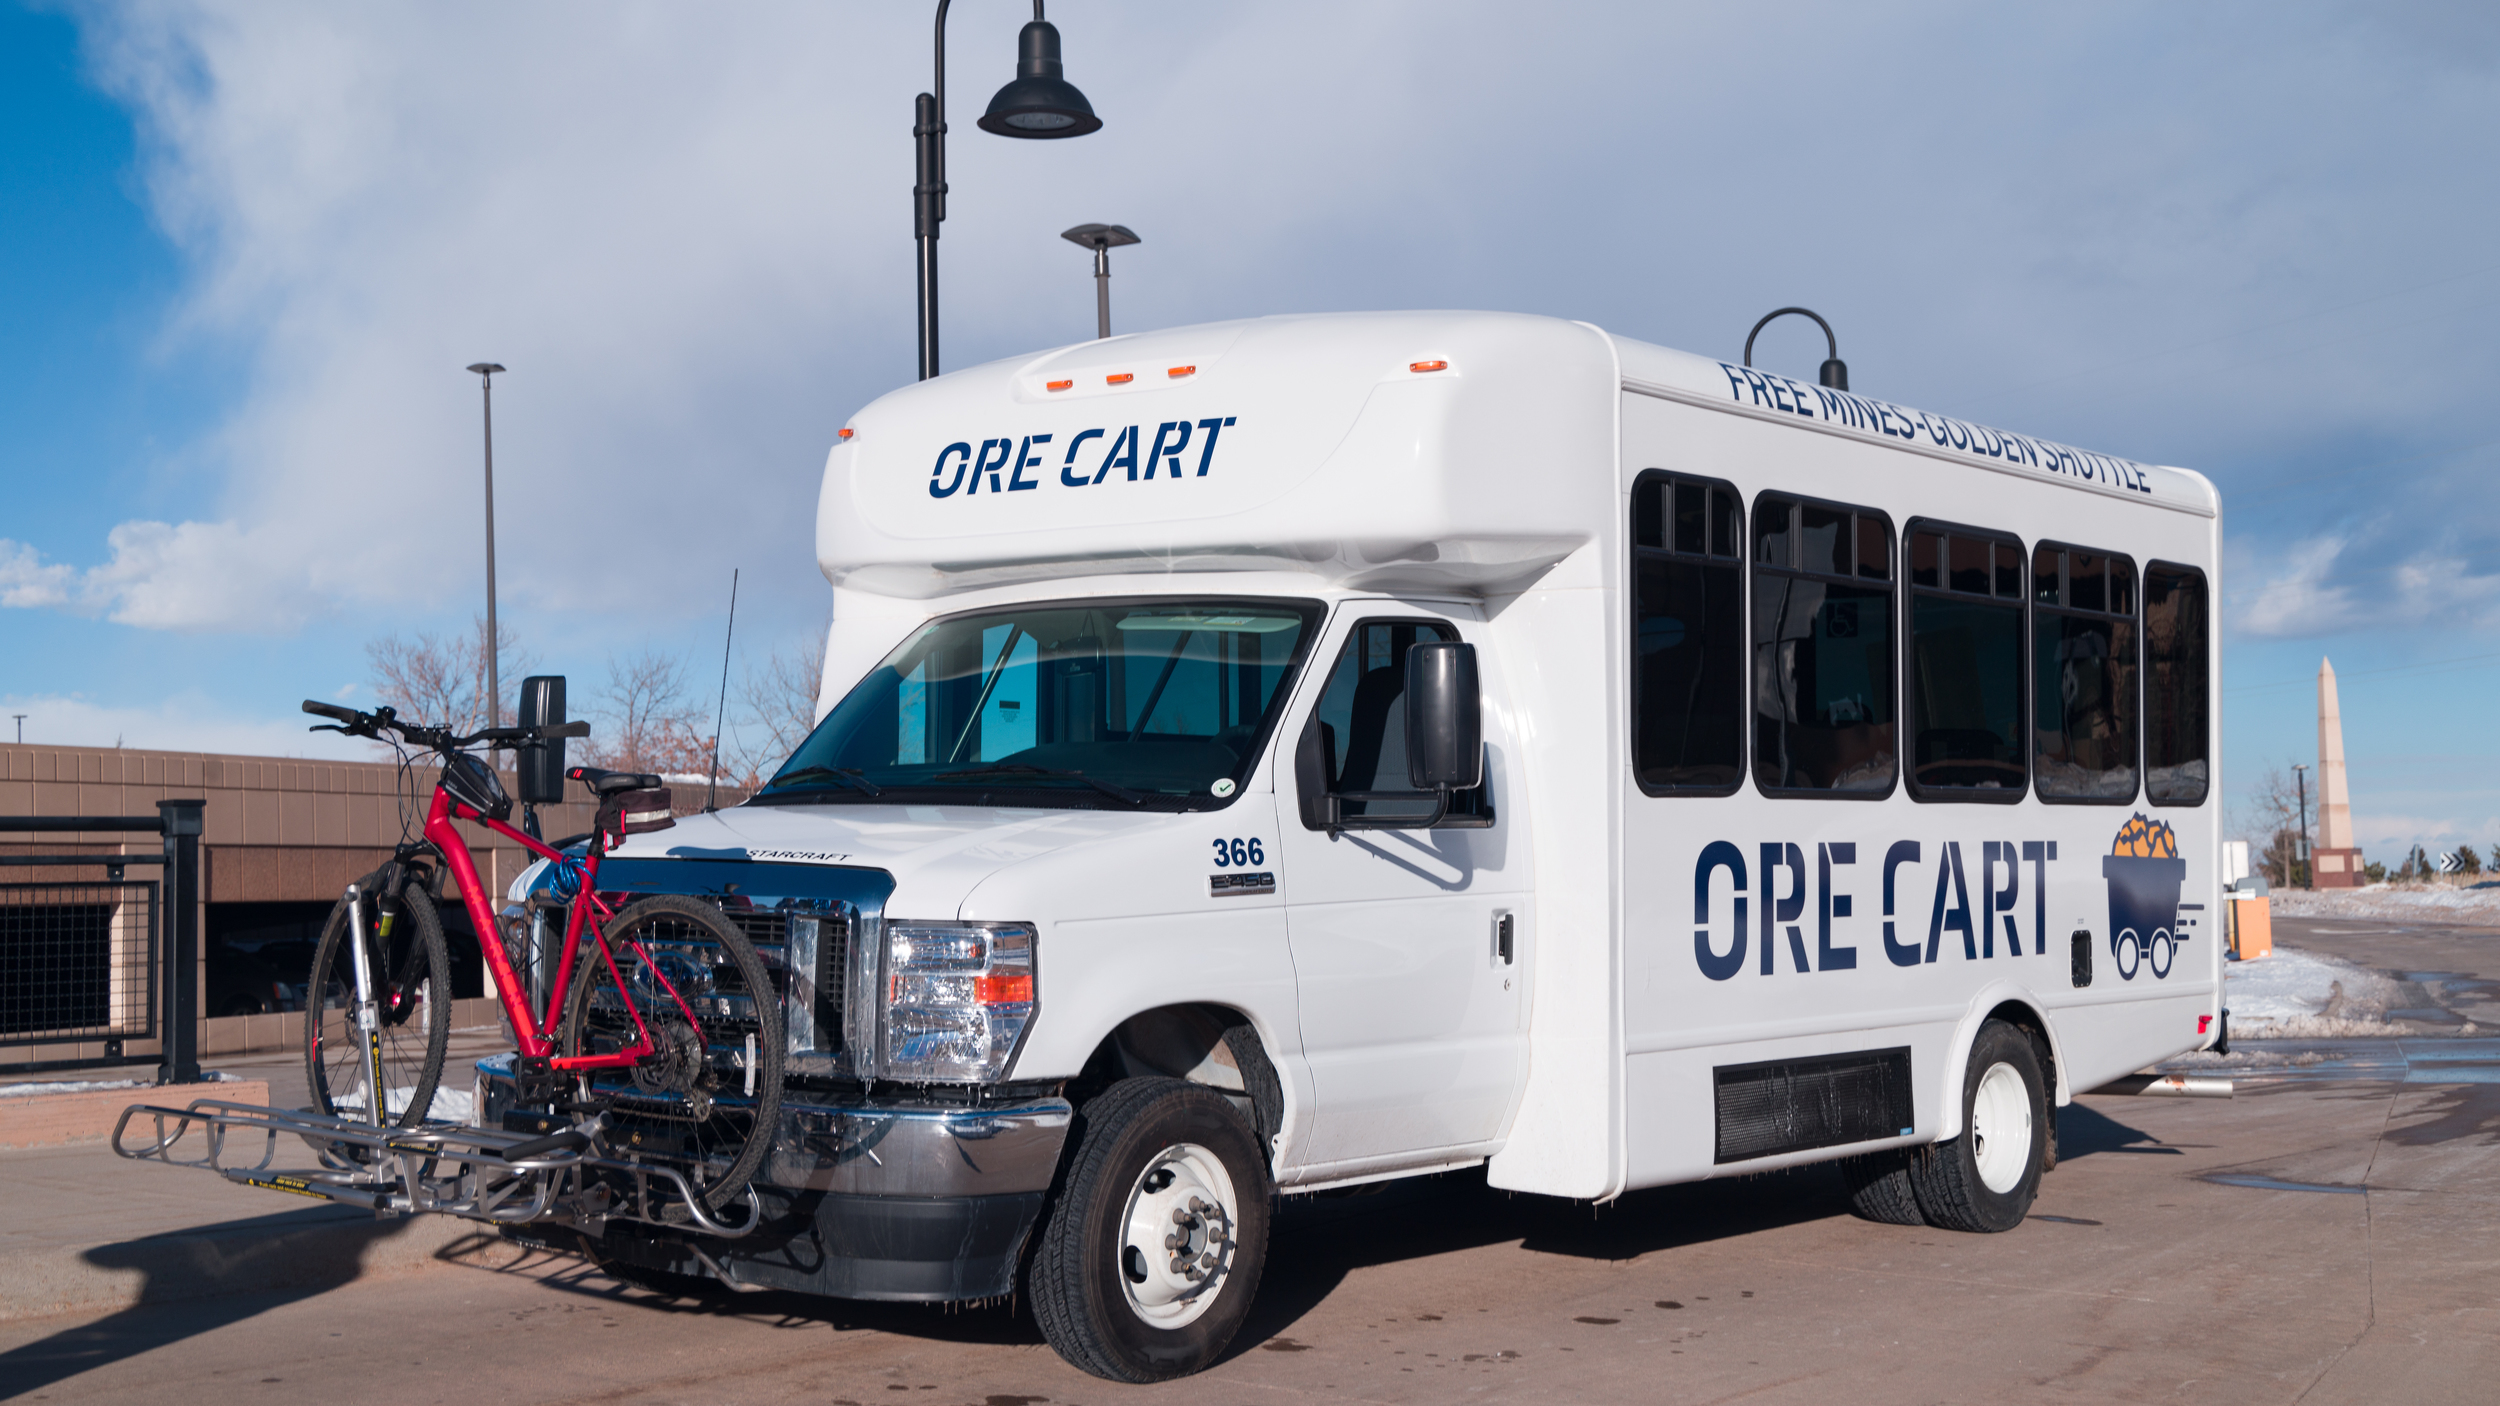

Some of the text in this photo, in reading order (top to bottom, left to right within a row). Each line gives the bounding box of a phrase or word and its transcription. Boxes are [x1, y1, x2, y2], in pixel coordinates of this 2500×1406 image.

[929, 416, 1237, 499] ORE CART
[1718, 362, 2152, 494] FREE MINES-GOLDEN SHUTTLE
[746, 849, 852, 861] STARCRAFT
[1212, 837, 1264, 867] 366
[1694, 839, 2057, 981] ORE CART
